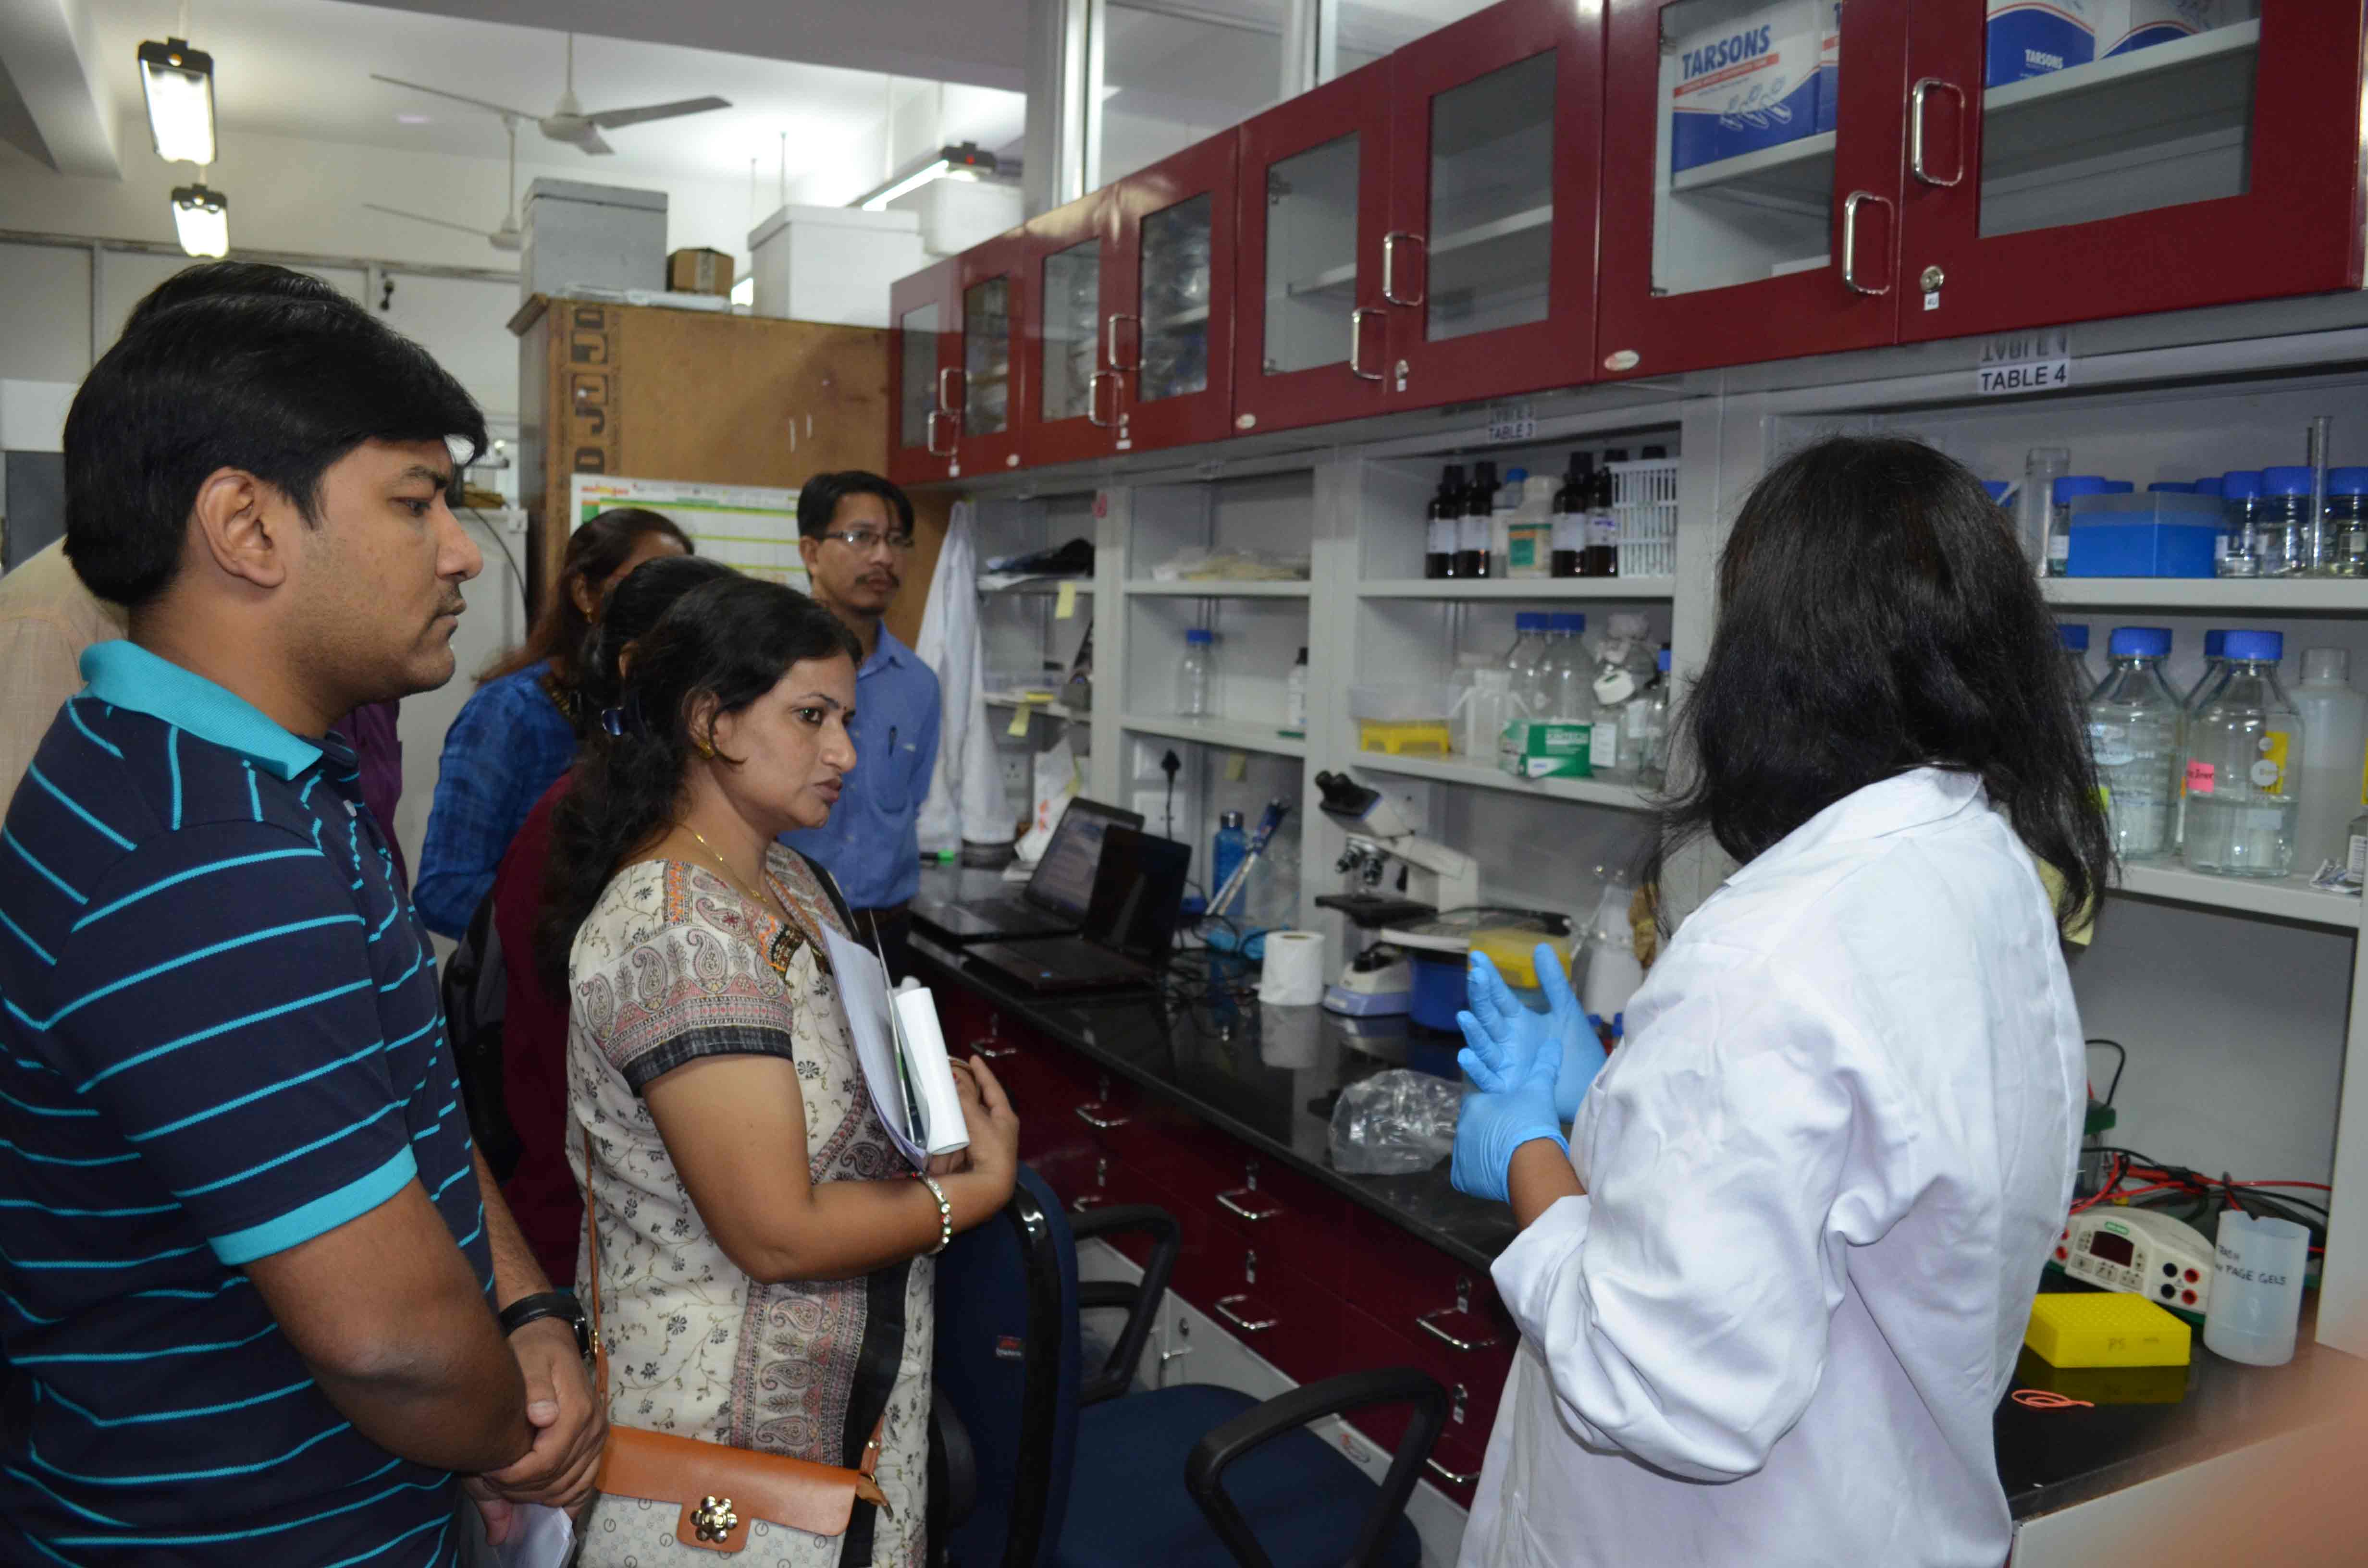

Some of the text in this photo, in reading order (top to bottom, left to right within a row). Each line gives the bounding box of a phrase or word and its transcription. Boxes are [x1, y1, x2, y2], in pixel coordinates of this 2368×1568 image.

[1683, 25, 1771, 80] TARSONS
[2025, 49, 2063, 70] TARSONS
[1981, 363, 2066, 392] TABLE 4
[1490, 423, 1522, 439] TABLE
